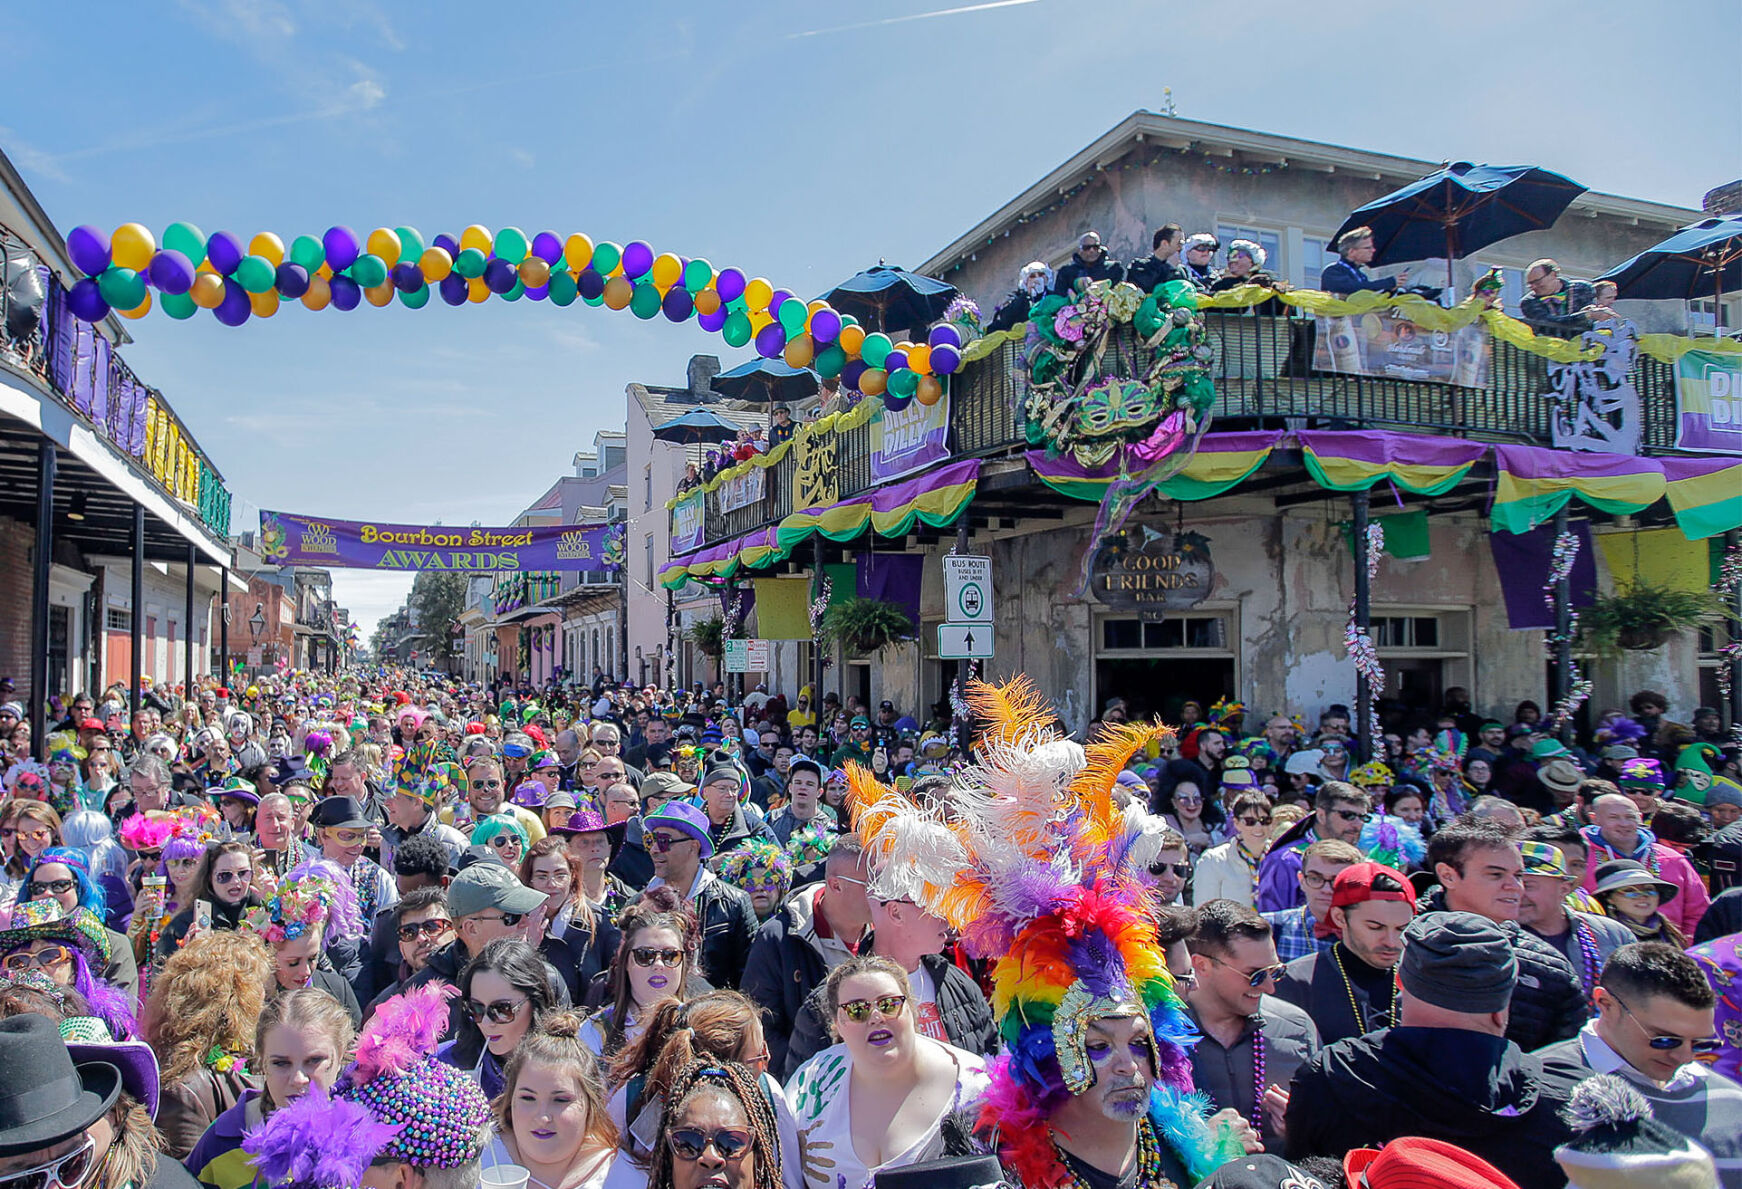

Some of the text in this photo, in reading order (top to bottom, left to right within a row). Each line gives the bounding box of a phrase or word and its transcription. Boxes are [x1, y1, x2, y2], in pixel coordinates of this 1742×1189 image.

[883, 420, 928, 456] DILLY
[301, 534, 337, 546] WOOD
[360, 524, 534, 548] Bourbon Street
[556, 542, 590, 553] WOOD
[376, 549, 520, 570] AWARDS
[952, 560, 986, 569] BUS ROUTE
[1122, 554, 1182, 571] GOOD
[1105, 572, 1199, 590] FRIENDS
[1135, 591, 1166, 602] BAR
